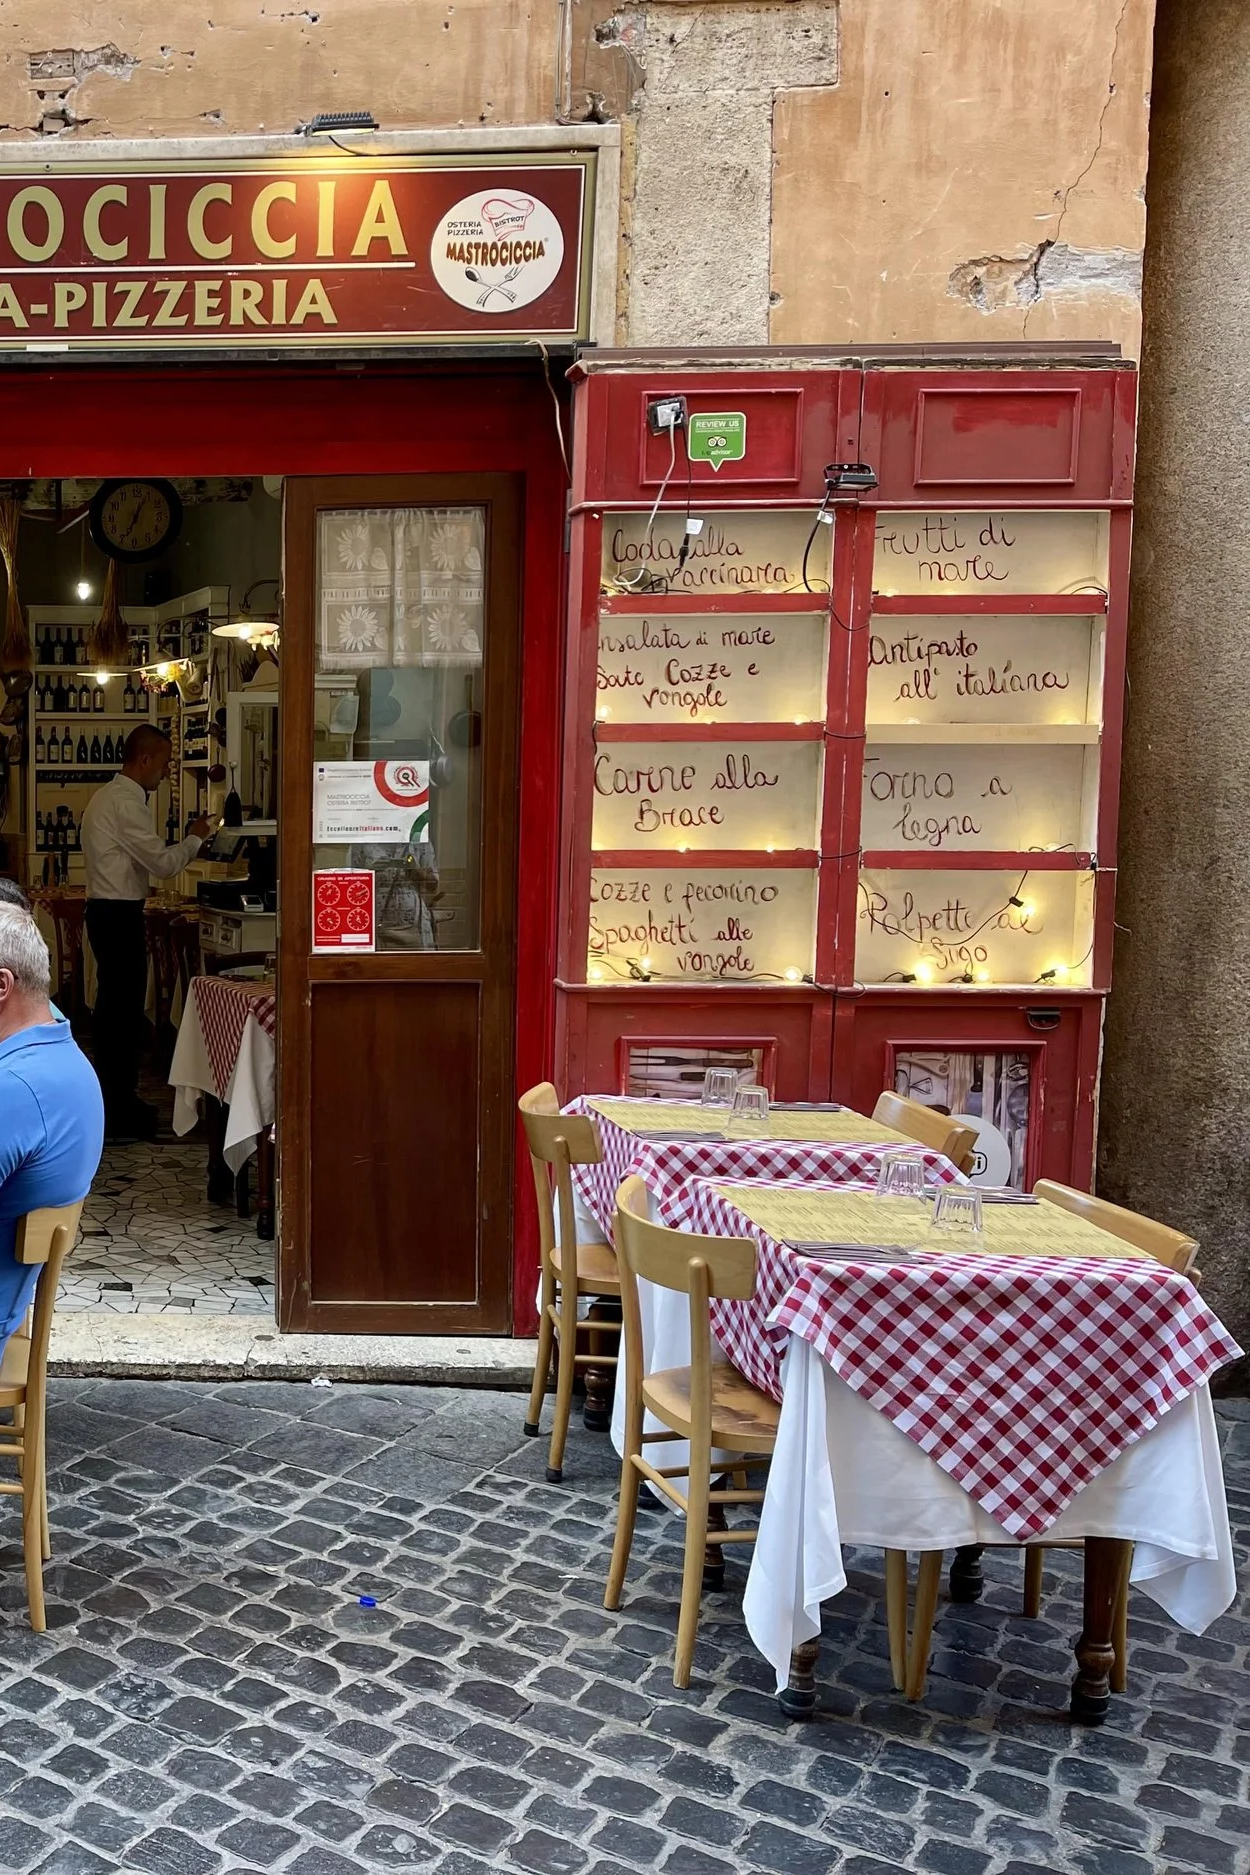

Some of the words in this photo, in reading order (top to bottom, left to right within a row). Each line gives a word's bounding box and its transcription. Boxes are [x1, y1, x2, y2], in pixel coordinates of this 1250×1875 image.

[494, 215, 525, 228] BISTROT
[446, 240, 545, 267] MASTROCICCIA
[696, 420, 726, 428] REVIEW
[689, 526, 744, 560] alla
[979, 516, 1016, 547] di
[918, 555, 1009, 582] mare
[598, 620, 691, 653] nsalata
[696, 631, 709, 646] di
[721, 627, 776, 647] mare
[665, 658, 732, 686] Cozze
[747, 662, 760, 676] e
[593, 755, 696, 796] Carne
[710, 754, 779, 791] alla
[981, 776, 1013, 797] a
[634, 799, 725, 832] Brace
[588, 909, 699, 955] Spaghetti
[711, 916, 754, 941] alle
